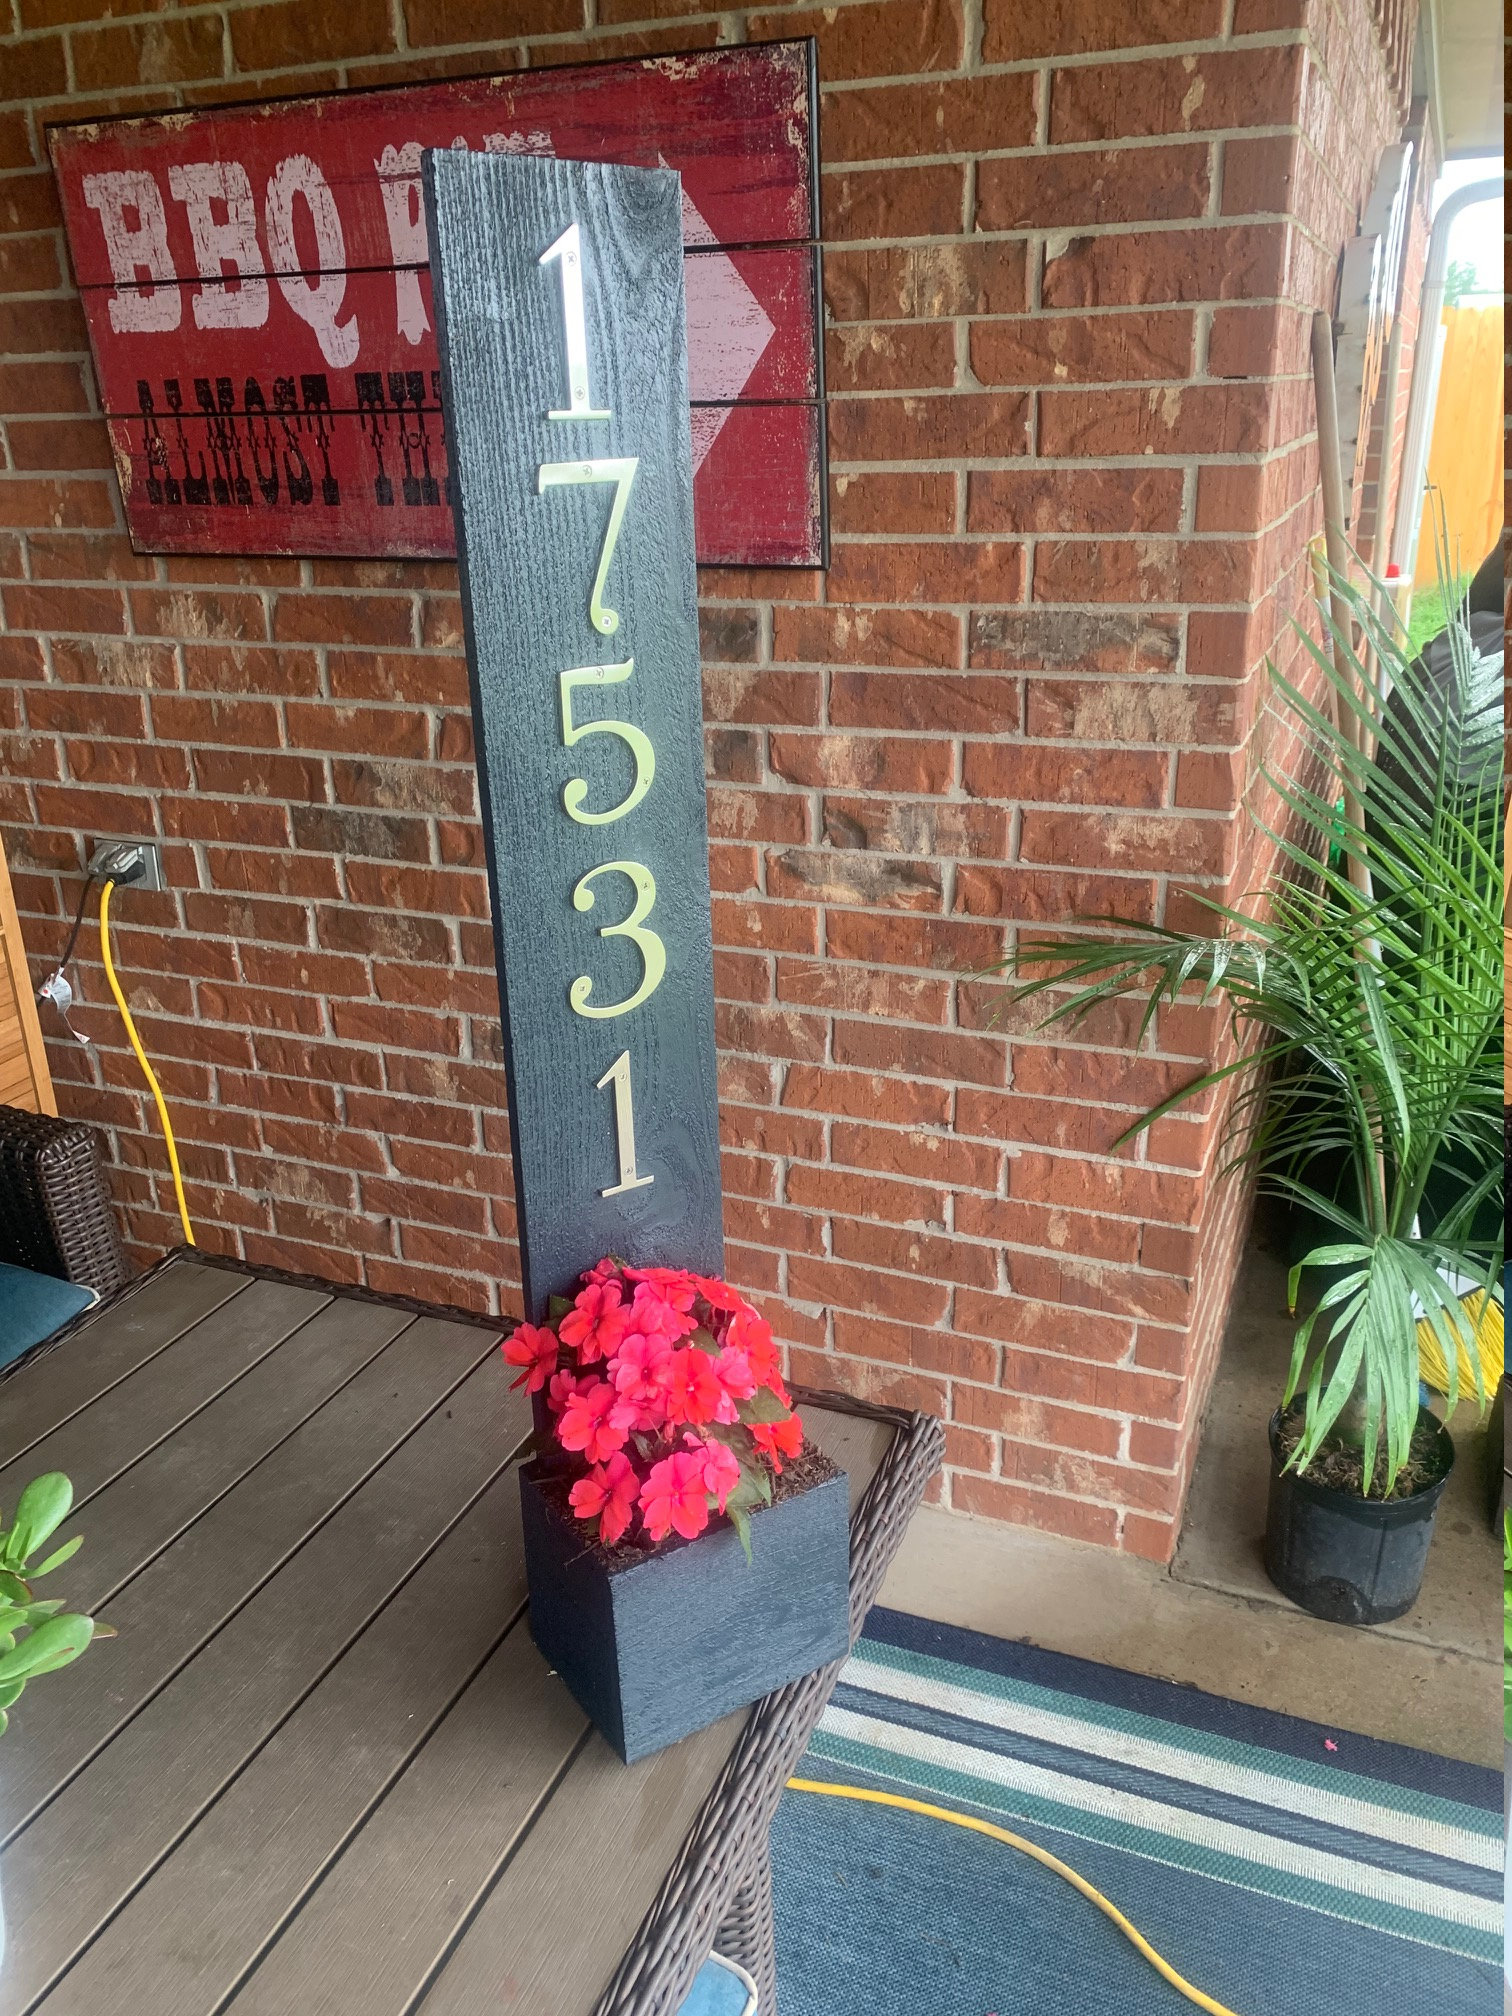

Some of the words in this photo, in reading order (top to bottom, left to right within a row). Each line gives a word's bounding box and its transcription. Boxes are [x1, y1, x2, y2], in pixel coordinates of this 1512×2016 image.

[82, 153, 360, 369] BBQ
[136, 373, 341, 506] ALMOST
[537, 222, 667, 1198] 17531
